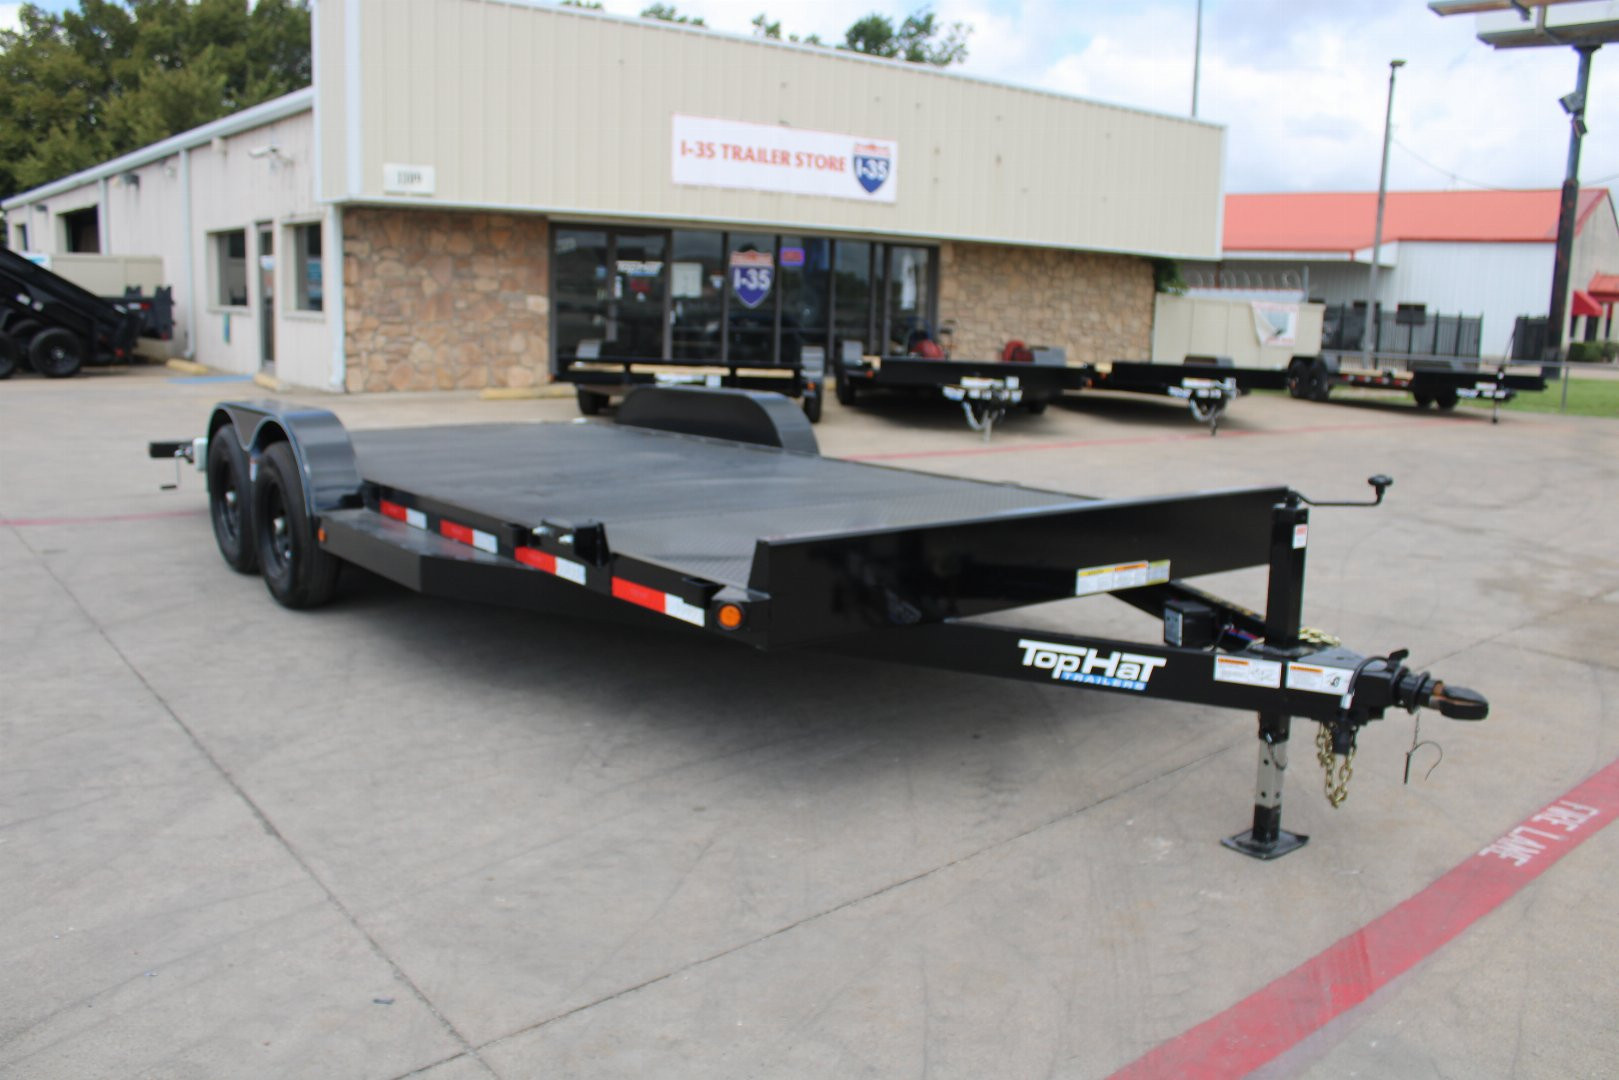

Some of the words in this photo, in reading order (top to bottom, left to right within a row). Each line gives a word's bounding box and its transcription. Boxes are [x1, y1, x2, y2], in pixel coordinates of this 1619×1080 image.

[680, 140, 715, 158] I-35
[720, 143, 791, 166] TRAILER
[795, 152, 847, 173] STORE
[855, 157, 889, 181] I-35
[733, 267, 771, 290] I-35
[1063, 672, 1146, 691] TRAILERS
[1532, 800, 1599, 832] FIRE
[1478, 826, 1562, 867] LANE
